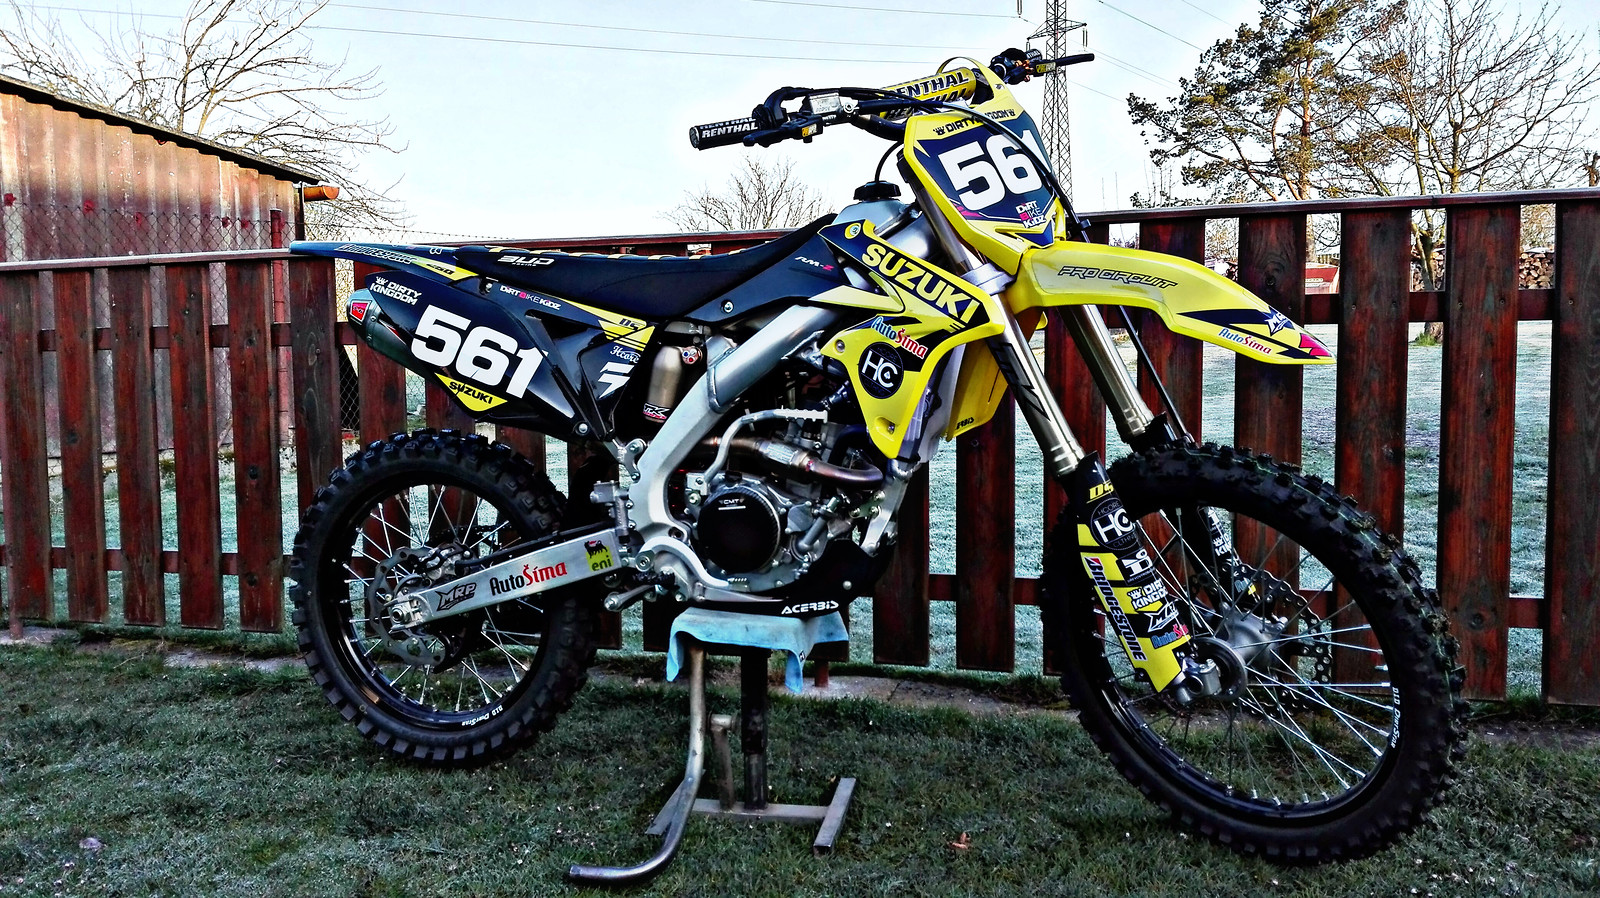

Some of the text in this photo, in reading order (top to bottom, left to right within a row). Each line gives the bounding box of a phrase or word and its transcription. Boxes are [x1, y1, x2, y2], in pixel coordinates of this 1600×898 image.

[702, 122, 759, 139] RENTHAL
[945, 117, 976, 132] DIRTY
[861, 243, 981, 323] SUZUKI
[1058, 266, 1178, 289] PRO CIRCUIT
[370, 282, 418, 306] KINGDOM
[387, 281, 422, 298] DIRTY
[411, 304, 548, 399] 561
[449, 381, 493, 404] SUZUKI
[592, 557, 612, 571] eni
[1084, 557, 1148, 661] BRIDGESTONE
[1132, 588, 1168, 610] KINGDO
